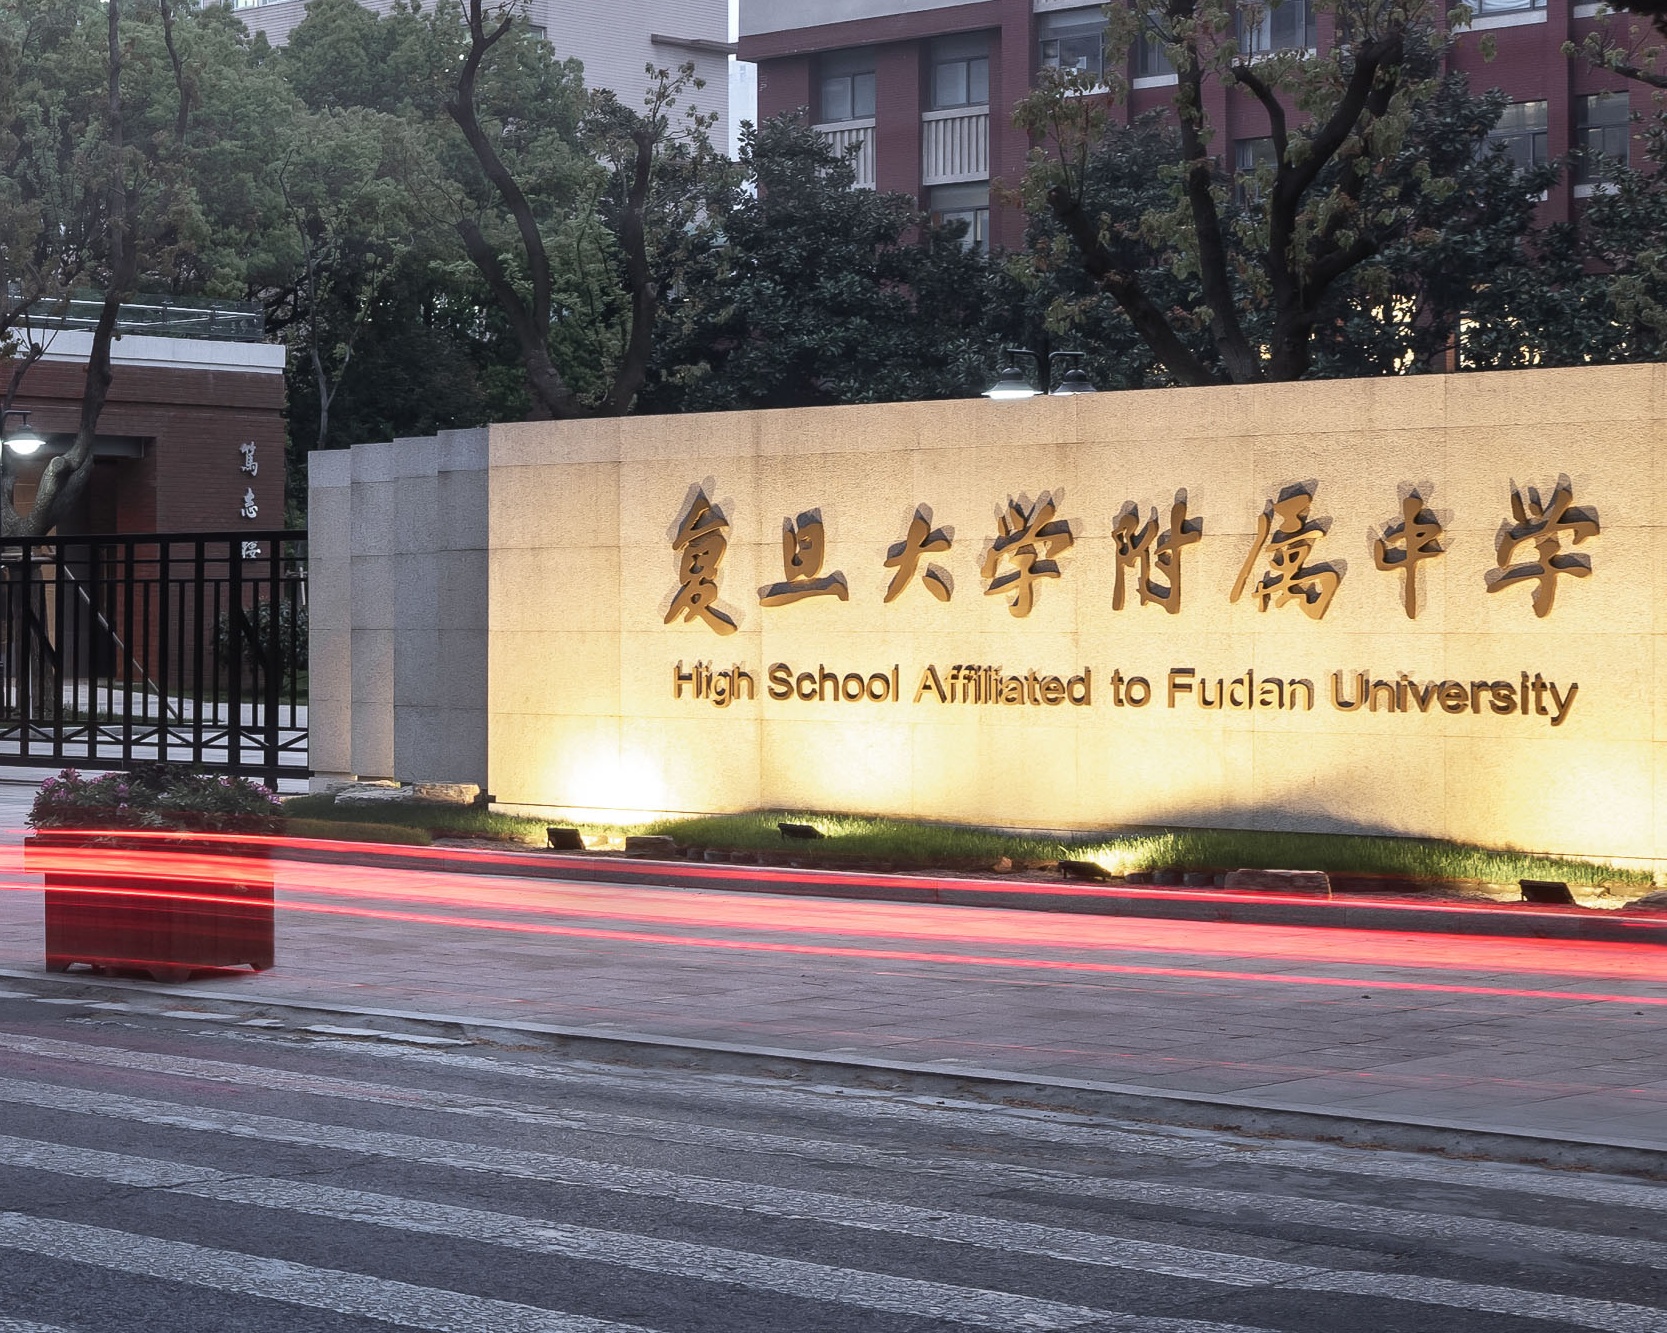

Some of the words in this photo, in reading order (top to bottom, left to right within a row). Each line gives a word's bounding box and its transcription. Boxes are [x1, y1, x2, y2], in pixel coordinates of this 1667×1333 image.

[663, 483, 1602, 636] 复旦大学附属中学
[673, 664, 755, 708] High
[766, 663, 899, 703] School
[913, 664, 1092, 707] Affiliated
[1110, 670, 1151, 708] to
[1167, 667, 1315, 711] Fudan
[1330, 669, 1579, 727] University
